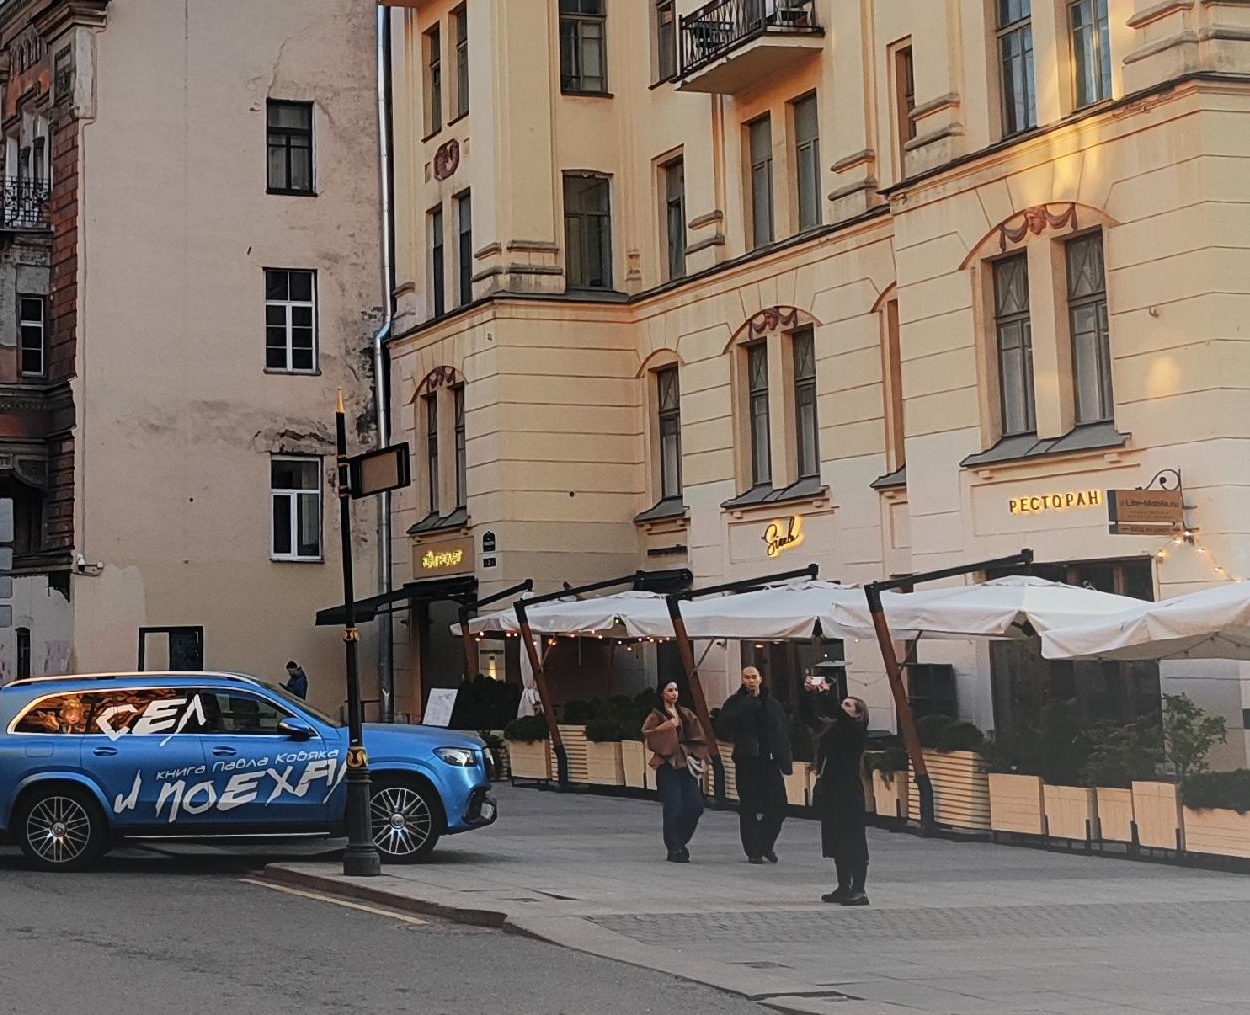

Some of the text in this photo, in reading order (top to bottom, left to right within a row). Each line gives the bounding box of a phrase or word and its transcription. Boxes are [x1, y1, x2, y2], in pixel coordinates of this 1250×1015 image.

[1008, 490, 1100, 513] РЕСТОРАН
[95, 692, 207, 748] СЕЛ
[212, 755, 270, 774] Павла
[275, 748, 340, 766] Кобяка
